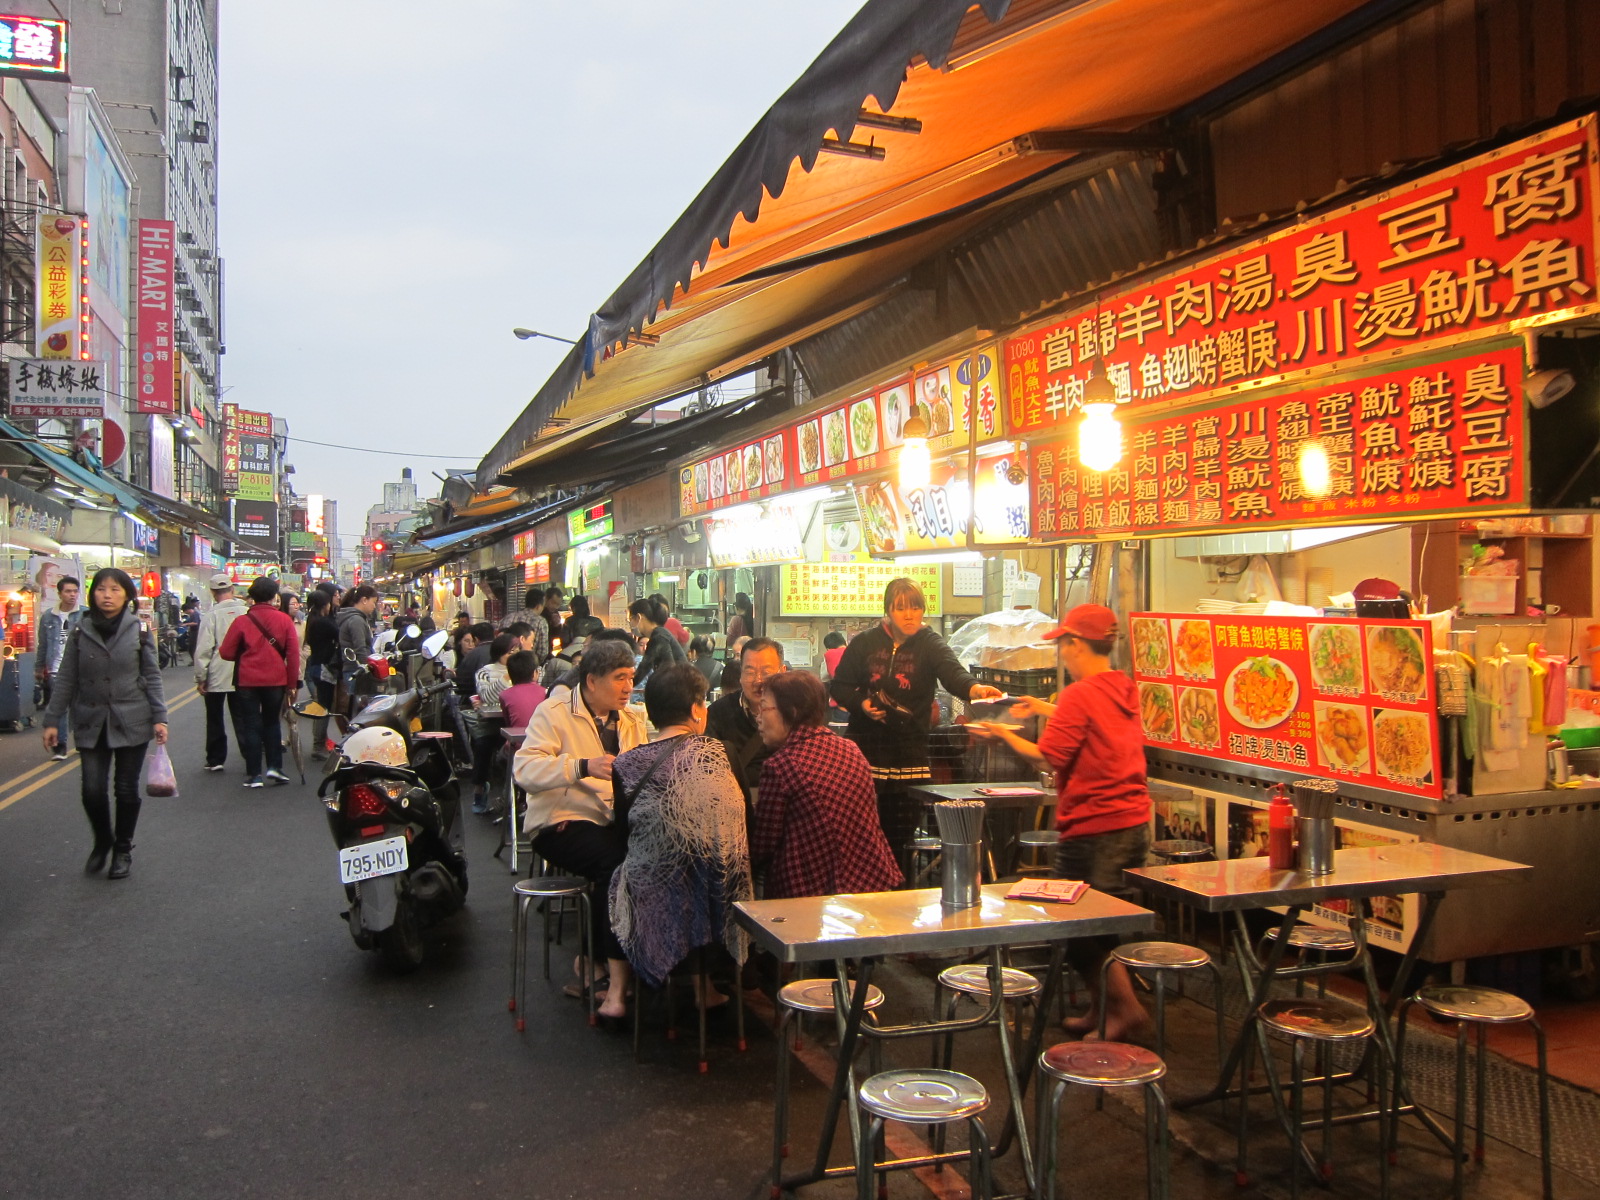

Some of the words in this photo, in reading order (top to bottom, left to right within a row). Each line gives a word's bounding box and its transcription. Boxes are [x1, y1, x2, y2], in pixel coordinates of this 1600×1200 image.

[48, 246, 67, 319] 公益彩券
[1010, 338, 1035, 360] 1090
[1024, 357, 1042, 426] 魷魚大王
[1460, 362, 1512, 498] 臭豆腐
[256, 443, 269, 460] 康
[1133, 430, 1160, 525] 羊肉麵線
[1162, 423, 1189, 522] 羊肉炒麵
[1192, 415, 1222, 521] 當歸羊肉湯
[1226, 407, 1273, 518] 川燙魷魚
[1359, 382, 1401, 493] 魷魚焿
[1037, 450, 1056, 532] 魯肉飯
[1058, 446, 1079, 531] 牛肉燴飯
[1215, 624, 1304, 651] 阿寶魚翅螃蟹焿
[1229, 731, 1310, 767] 招牌燙魷魚
